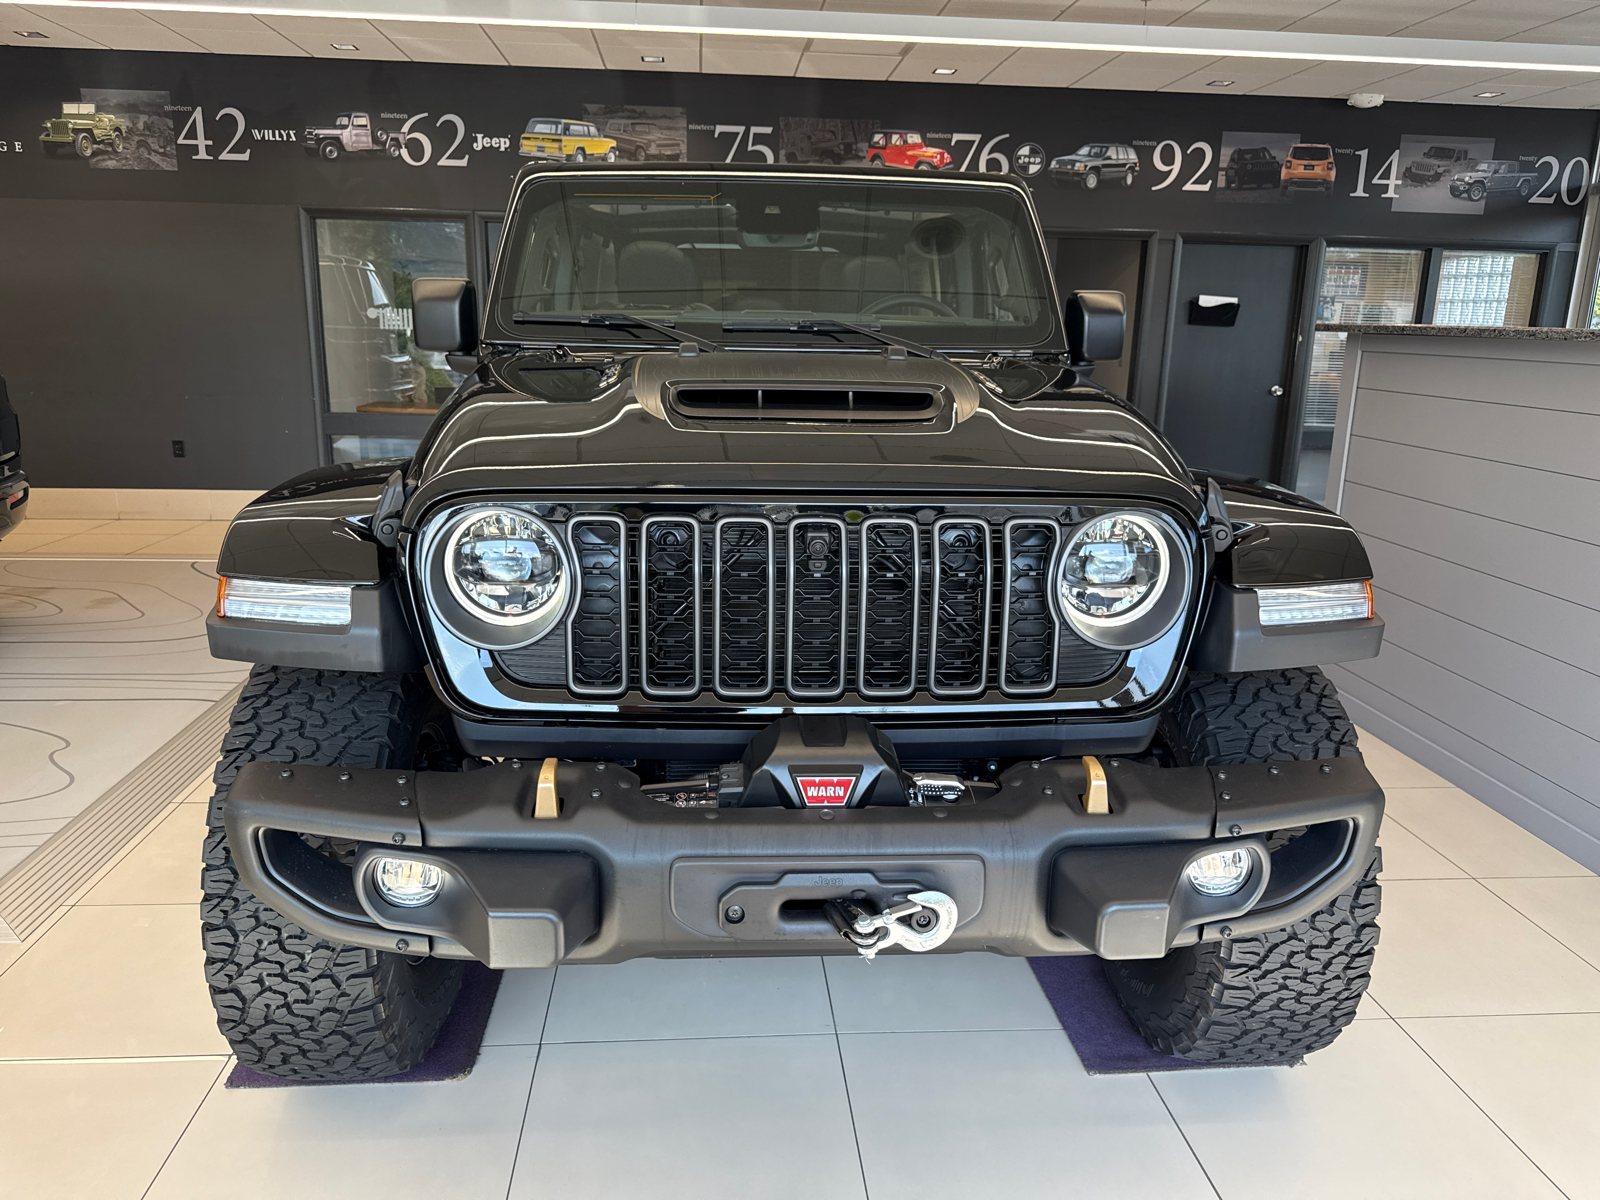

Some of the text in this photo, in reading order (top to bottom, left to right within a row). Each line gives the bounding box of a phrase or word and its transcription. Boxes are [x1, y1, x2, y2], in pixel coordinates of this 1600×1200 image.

[164, 104, 251, 161] nineteen 42
[251, 129, 297, 141] WILLYS
[400, 112, 469, 167] 62
[688, 123, 774, 164] nineteen 75
[951, 133, 1010, 174] 76
[1018, 155, 1041, 164] Jeep
[1151, 140, 1213, 191] 92
[1349, 148, 1402, 198] 14
[1518, 155, 1590, 206] twenty 20
[807, 786, 844, 797] WARN
[814, 876, 843, 888] Jeep
